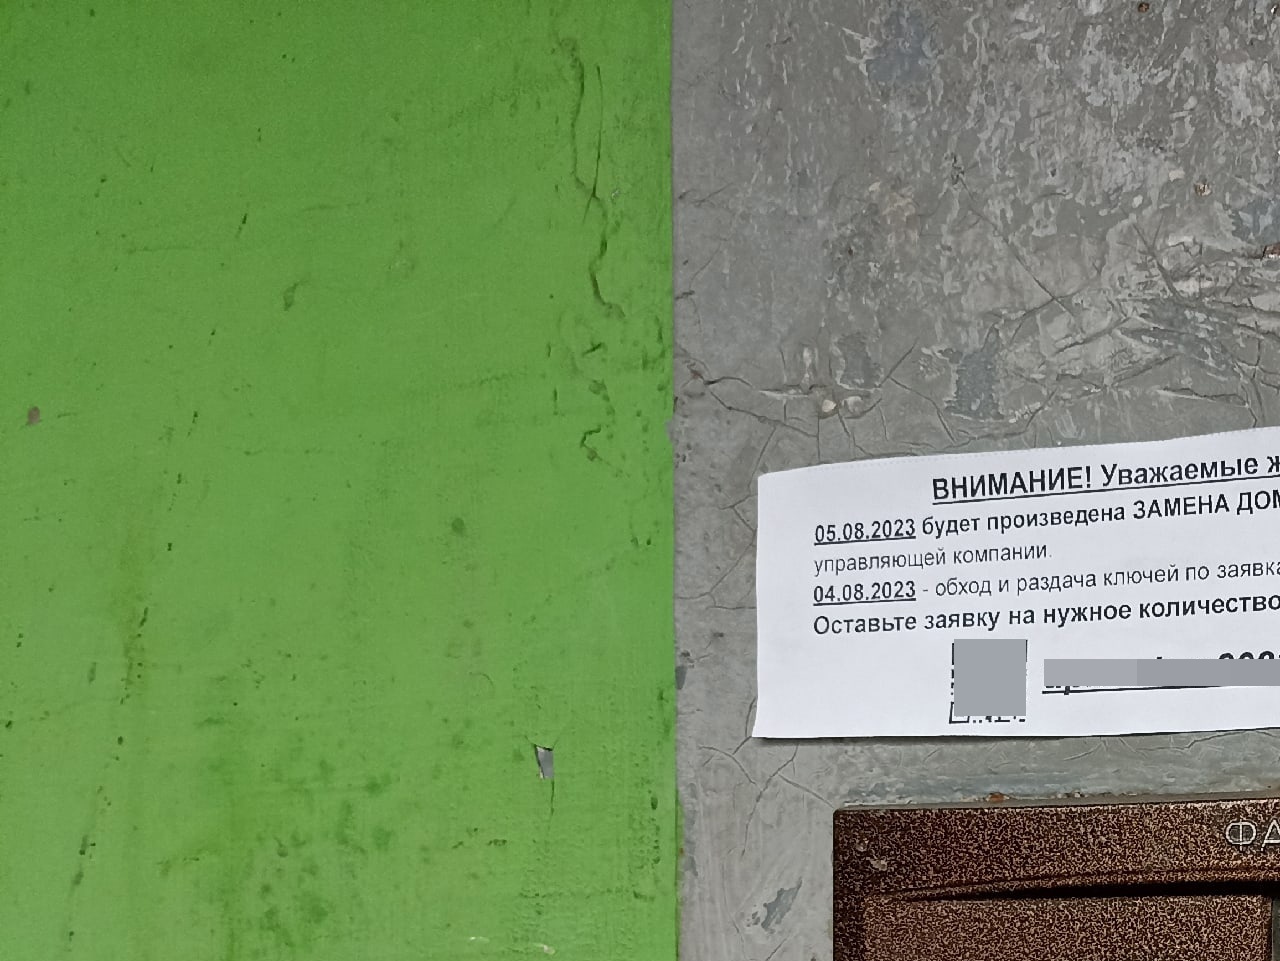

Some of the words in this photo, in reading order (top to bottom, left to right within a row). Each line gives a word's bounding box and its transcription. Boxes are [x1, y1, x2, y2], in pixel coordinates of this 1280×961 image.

[933, 466, 1092, 500] ВНИМАНИЕ!
[1101, 455, 1258, 487] Уважаемые
[815, 518, 917, 544] 05.08.2023
[922, 515, 980, 539] будет
[987, 505, 1125, 533] произведена
[1133, 494, 1229, 520] ЗАМЕНА
[814, 548, 946, 575] управляющей
[953, 544, 1053, 565] компании.
[814, 580, 916, 604] 04.08.2023
[935, 579, 992, 598] обход
[998, 577, 1010, 593] и
[1017, 572, 1097, 600] раздача
[1103, 564, 1179, 588] ключей
[1185, 566, 1210, 583] по
[813, 615, 917, 636] Оставьте
[924, 609, 1000, 633] заявку
[1009, 608, 1036, 625] на
[1043, 601, 1132, 627] нужное
